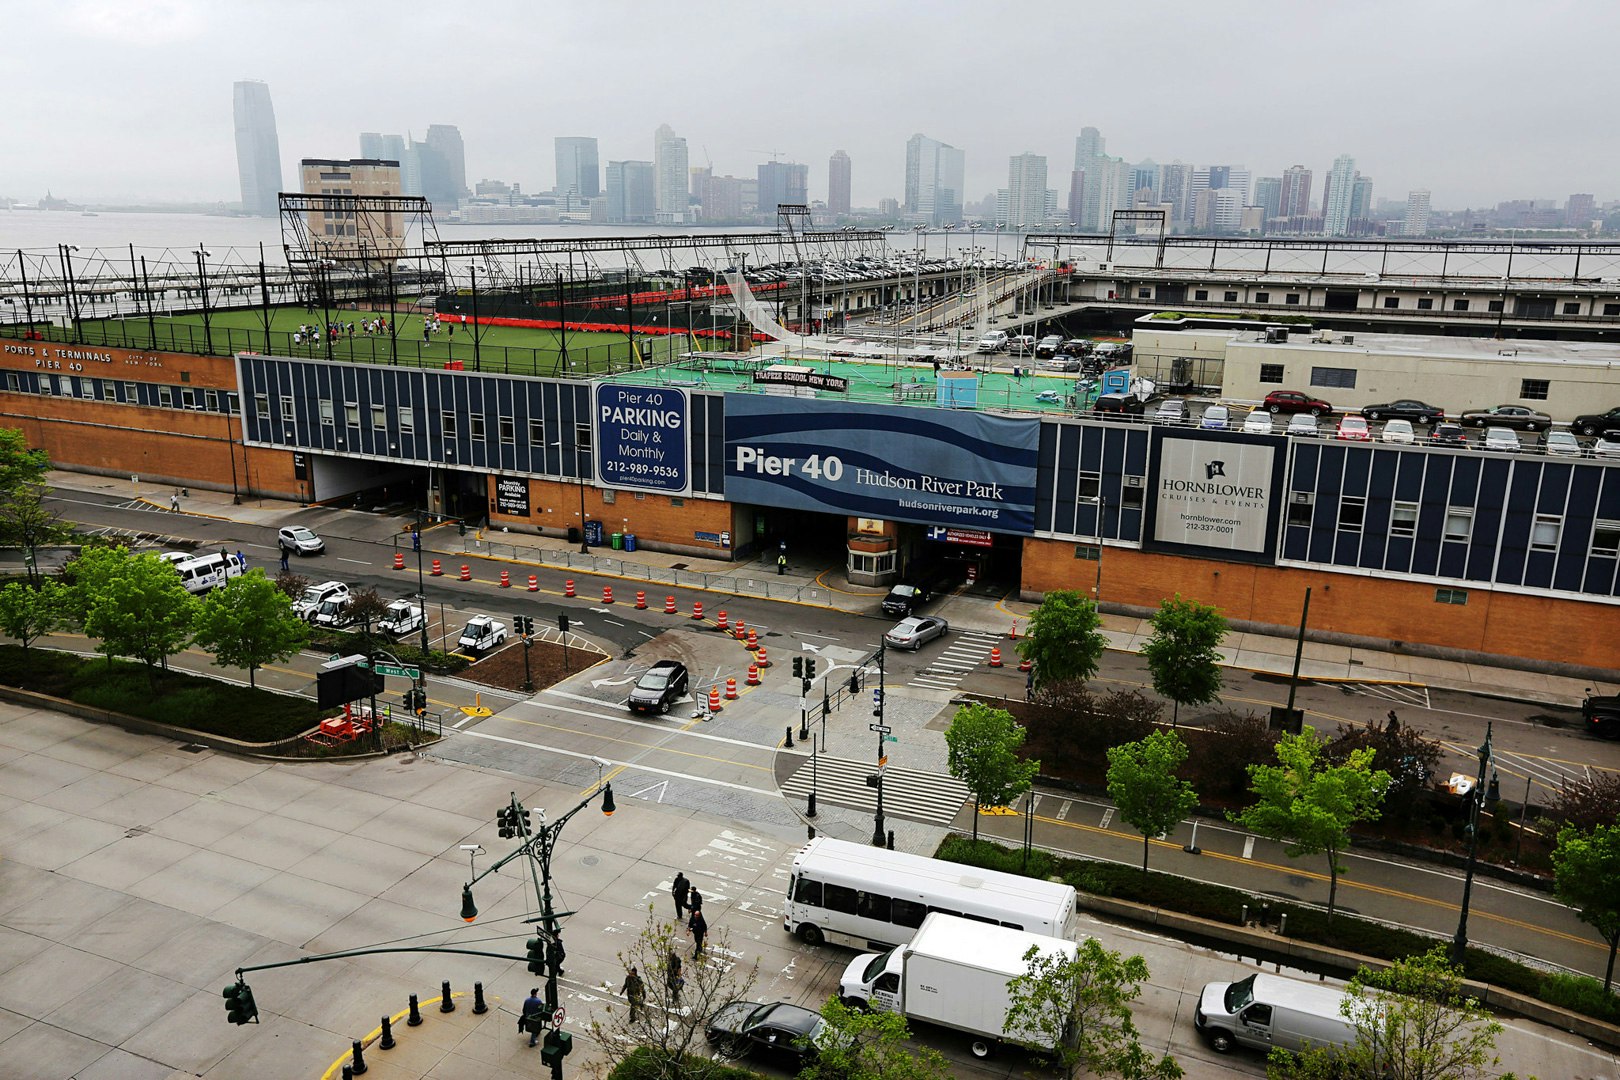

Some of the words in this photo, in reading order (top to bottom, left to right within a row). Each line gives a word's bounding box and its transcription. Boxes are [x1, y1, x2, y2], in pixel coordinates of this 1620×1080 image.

[4, 345, 34, 355] PORTS
[42, 348, 48, 356] &
[55, 349, 110, 362] TERMINALS
[36, 359, 60, 368] PIER
[69, 362, 82, 371] 40
[756, 372, 782, 380] TRAPEZE
[784, 373, 807, 382] SCHOOL
[808, 376, 824, 384] NEW
[826, 378, 844, 387] YORK
[618, 391, 642, 404] Pier
[646, 394, 662, 406] 40
[602, 406, 681, 428] PARKING
[621, 428, 649, 444] Daily
[652, 431, 662, 443] &
[619, 444, 664, 462] Monthly
[607, 461, 678, 478] 212-989-9536
[737, 446, 795, 476] Pier
[802, 454, 843, 481] 40
[499, 484, 526, 493] PARKING
[856, 468, 917, 490] Hudson
[921, 476, 963, 495] River
[966, 480, 1003, 500] Park
[1163, 479, 1264, 499] HORNBLOWER
[899, 499, 999, 518] hudsonriverpark.org
[1162, 494, 1206, 502] CRUISES
[1225, 500, 1264, 508] EVENTS
[1180, 513, 1241, 526] hornblower.com
[934, 526, 946, 538] P
[1186, 523, 1233, 533] 212-337-0001
